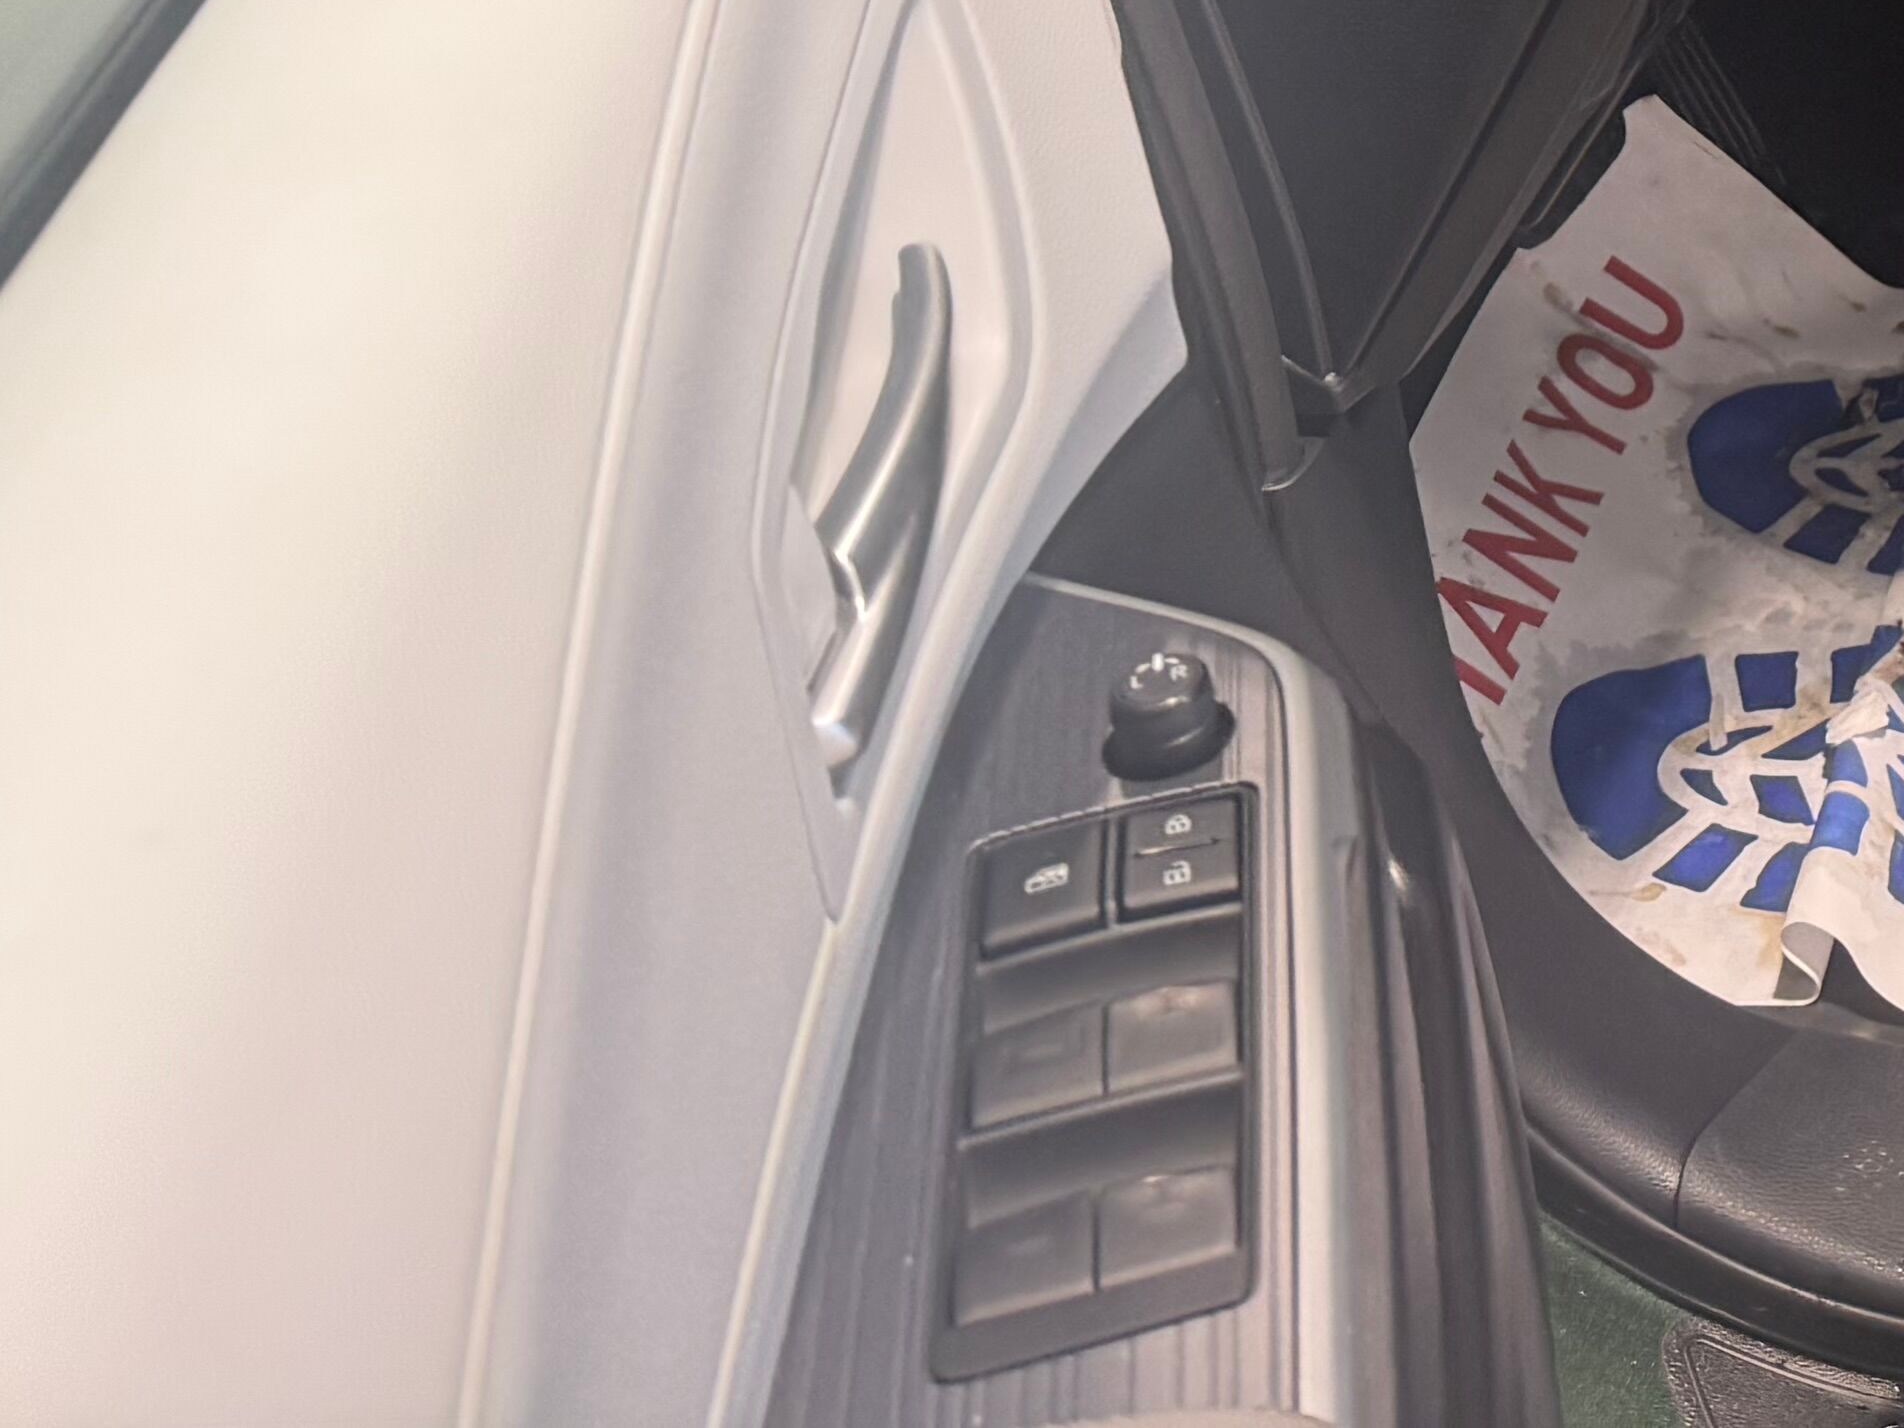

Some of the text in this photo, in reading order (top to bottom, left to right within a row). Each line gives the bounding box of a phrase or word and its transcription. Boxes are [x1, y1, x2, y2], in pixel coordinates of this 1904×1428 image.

[1434, 254, 1684, 706] ANK YOU
[1170, 665, 1188, 682] R
[1130, 676, 1143, 689] L
